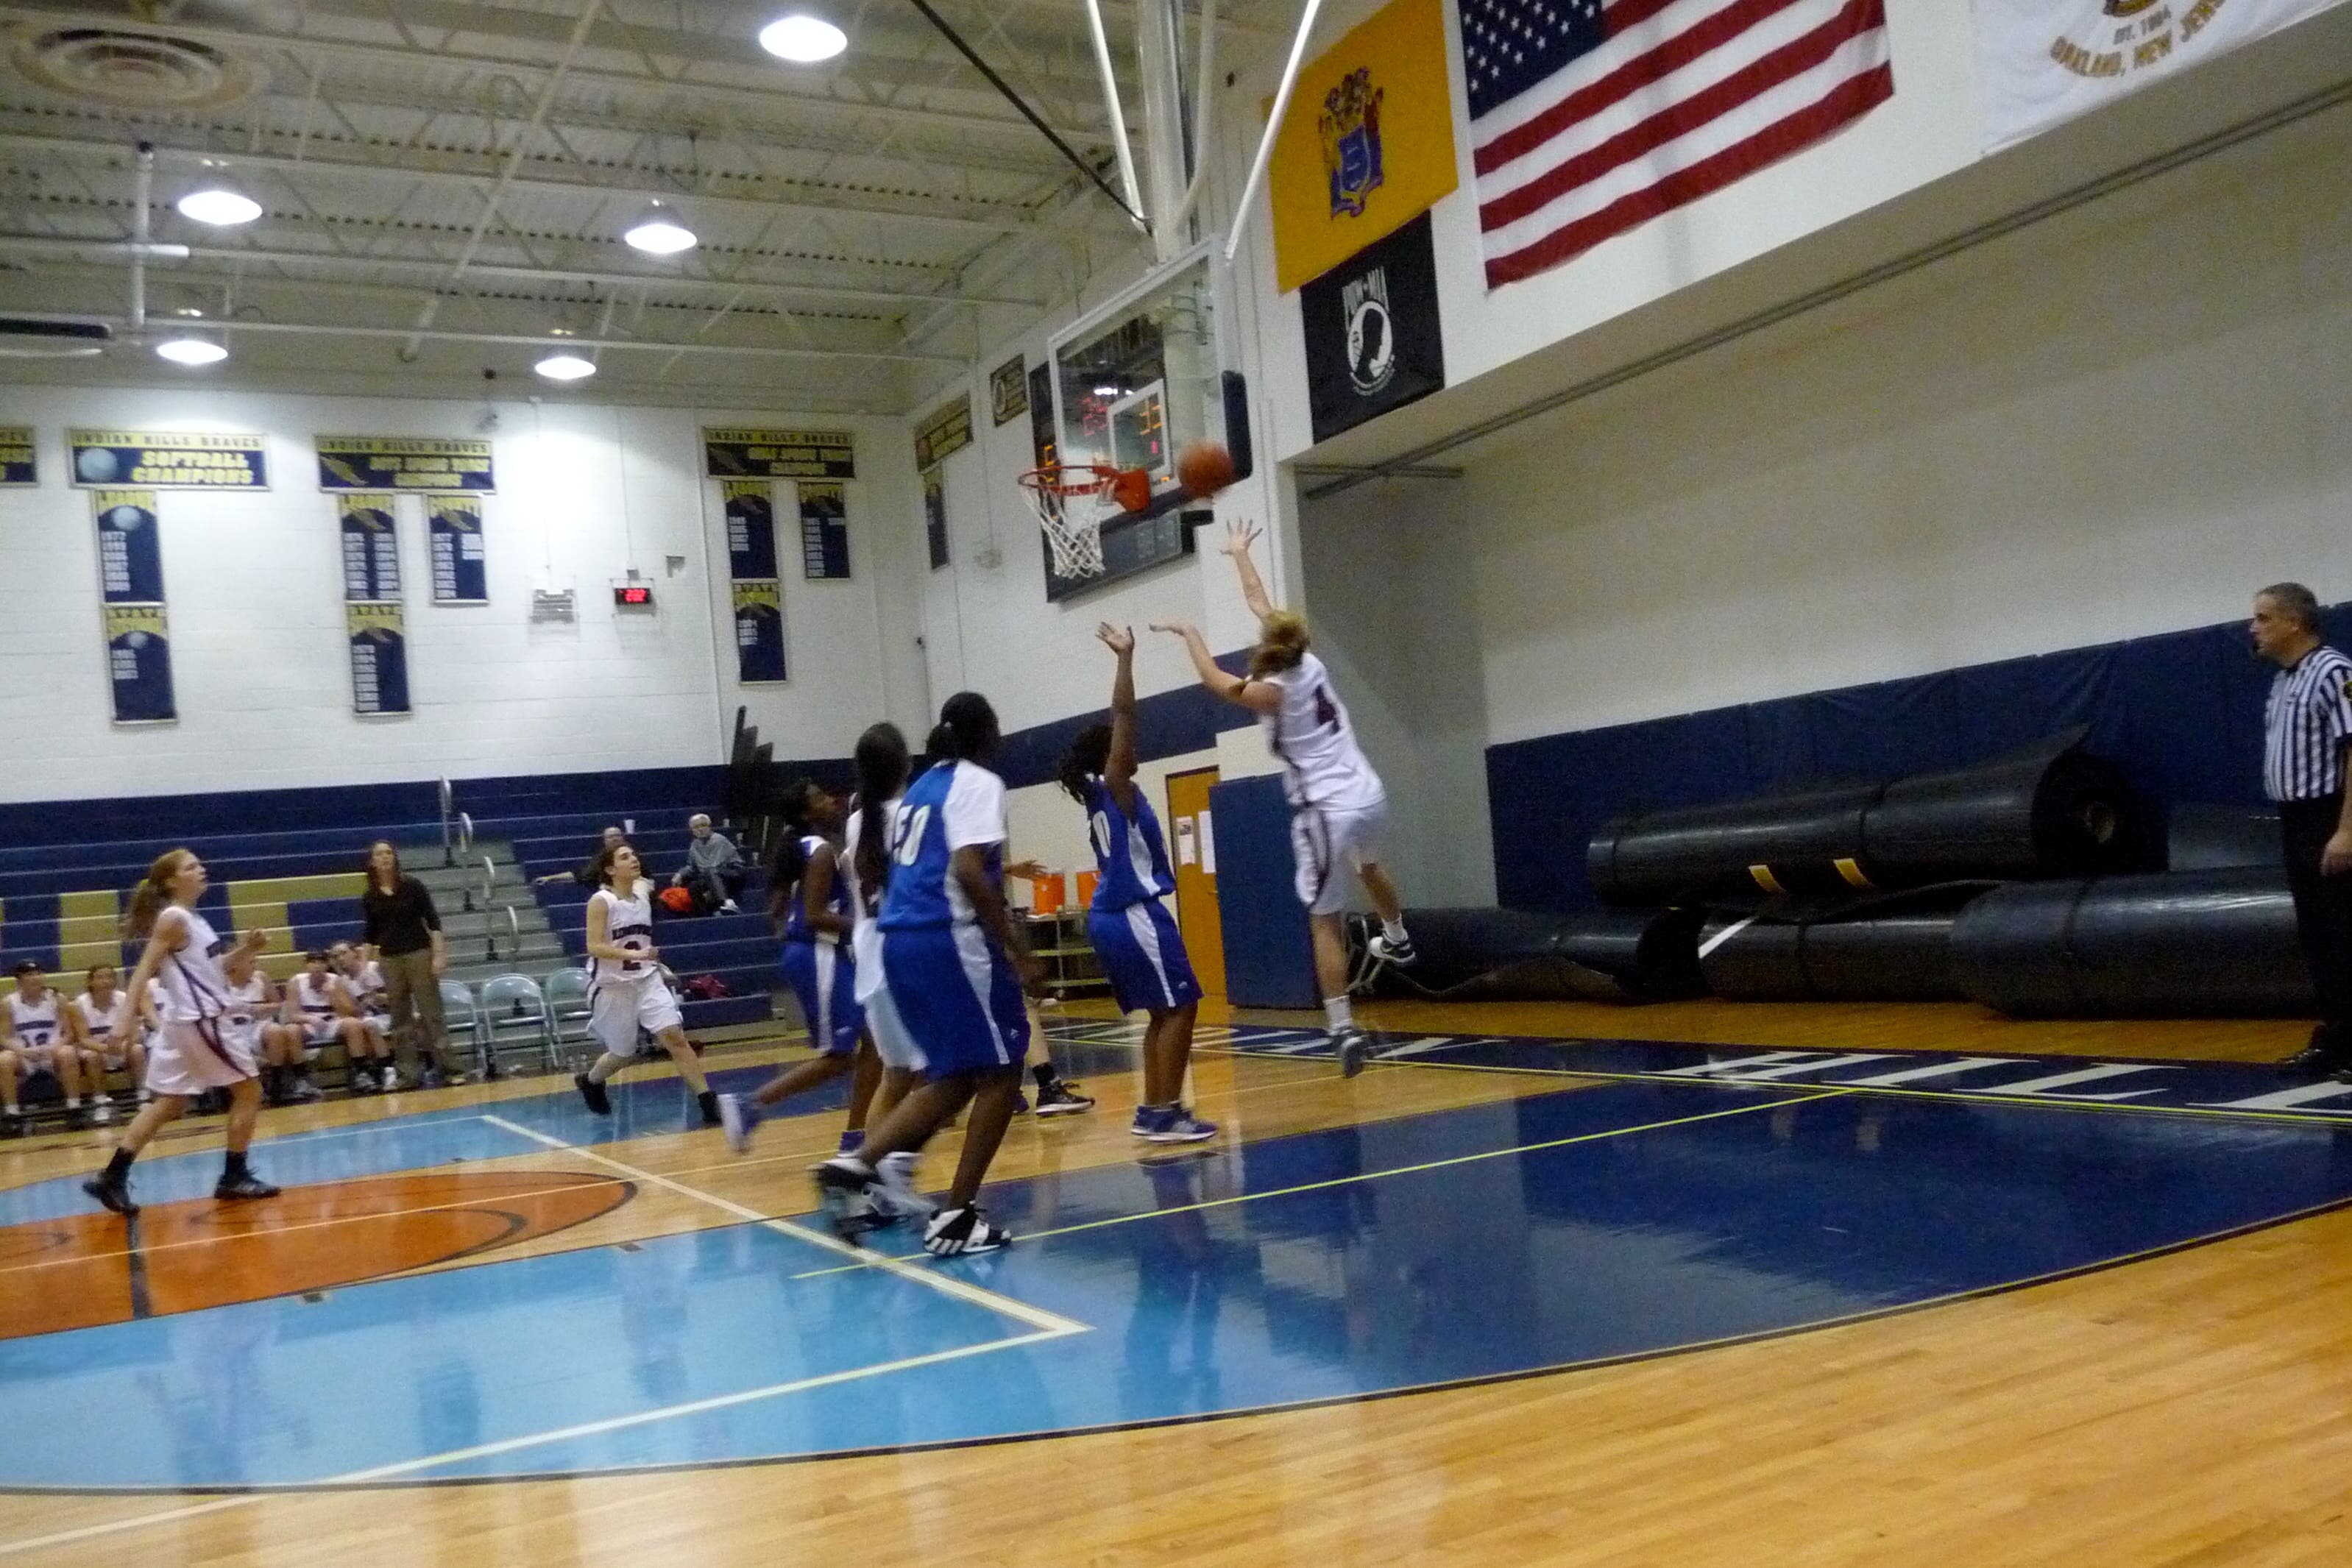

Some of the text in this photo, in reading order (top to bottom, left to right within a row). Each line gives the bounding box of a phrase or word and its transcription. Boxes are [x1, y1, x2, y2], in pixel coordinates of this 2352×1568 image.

[201, 436, 260, 447] BRAVES
[141, 450, 249, 467] SOFTBALL
[131, 467, 254, 484] CHAMPIONS
